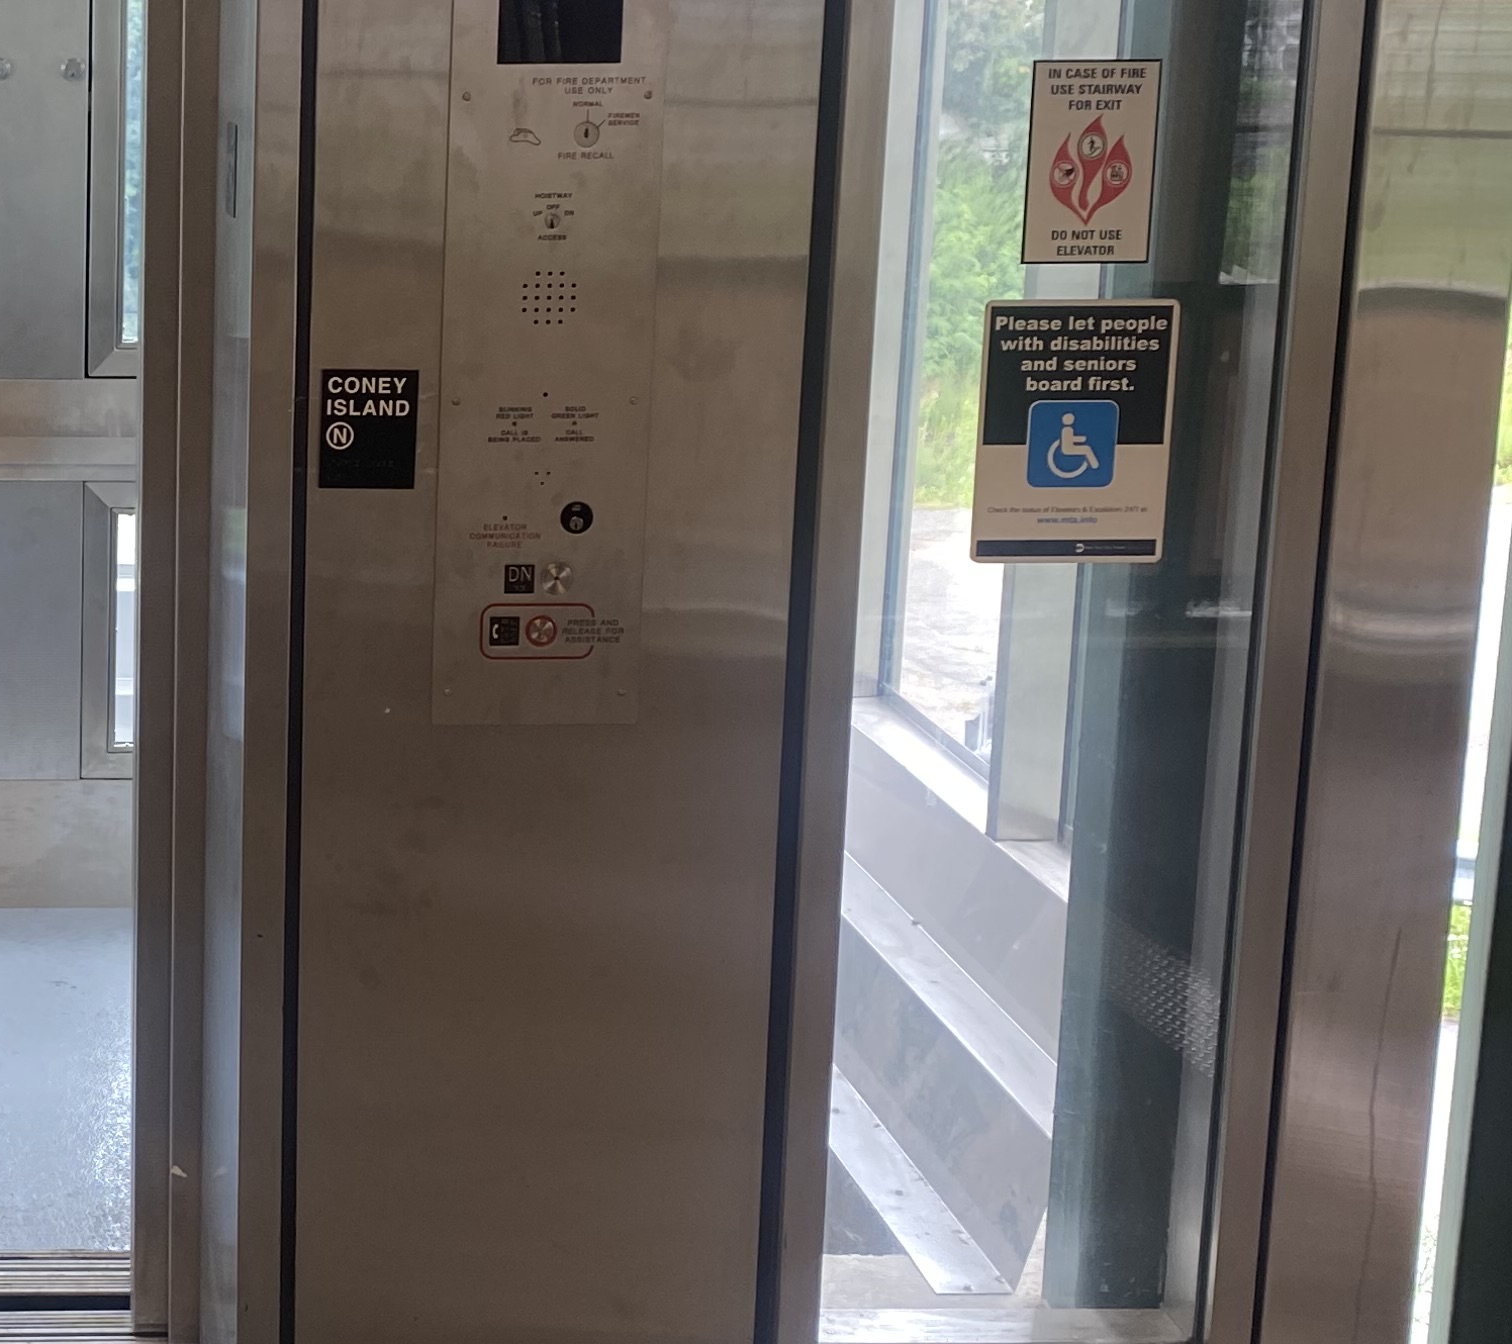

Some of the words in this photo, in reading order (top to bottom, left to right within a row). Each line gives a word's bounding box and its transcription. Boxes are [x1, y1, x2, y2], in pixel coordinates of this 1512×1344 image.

[1048, 68, 1062, 79] IN
[1065, 68, 1098, 79] CASE
[1101, 68, 1116, 79] OF
[1120, 67, 1148, 78] FIRE
[532, 77, 552, 85] FOR
[556, 77, 578, 85] FIRE
[581, 76, 646, 85] DEPARTMENT
[564, 87, 583, 95] USE
[1051, 84, 1075, 95] USE
[1078, 83, 1143, 95] STAIRWAY
[1068, 100, 1092, 111] FOR
[1096, 99, 1123, 110] EXIT
[558, 152, 577, 160] FIRE
[1051, 230, 1068, 241] DO
[1071, 229, 1096, 241] NOT
[1099, 229, 1123, 241] USE
[1056, 245, 1115, 256] ELEVATOR
[995, 316, 1062, 331] Please
[1068, 316, 1095, 331] let
[1100, 316, 1168, 334] people
[1000, 336, 1044, 351] with
[1050, 336, 1160, 351] disabilities
[1020, 356, 1058, 371] and
[1063, 356, 1137, 371] seniors
[327, 376, 407, 394] CONEY
[1026, 376, 1083, 392] board
[1088, 376, 1135, 391] first.
[326, 398, 410, 417] ISLAND
[332, 427, 348, 445] N
[1037, 516, 1098, 524] www.mta.info
[483, 523, 527, 532] ELEVATOR
[469, 532, 542, 540] COMMUNICATION
[486, 541, 522, 549] FAILURE
[508, 566, 533, 583] DN
[561, 627, 602, 635] RELEASE
[605, 627, 625, 635] FOR
[564, 636, 621, 644] ASSISTANCE
